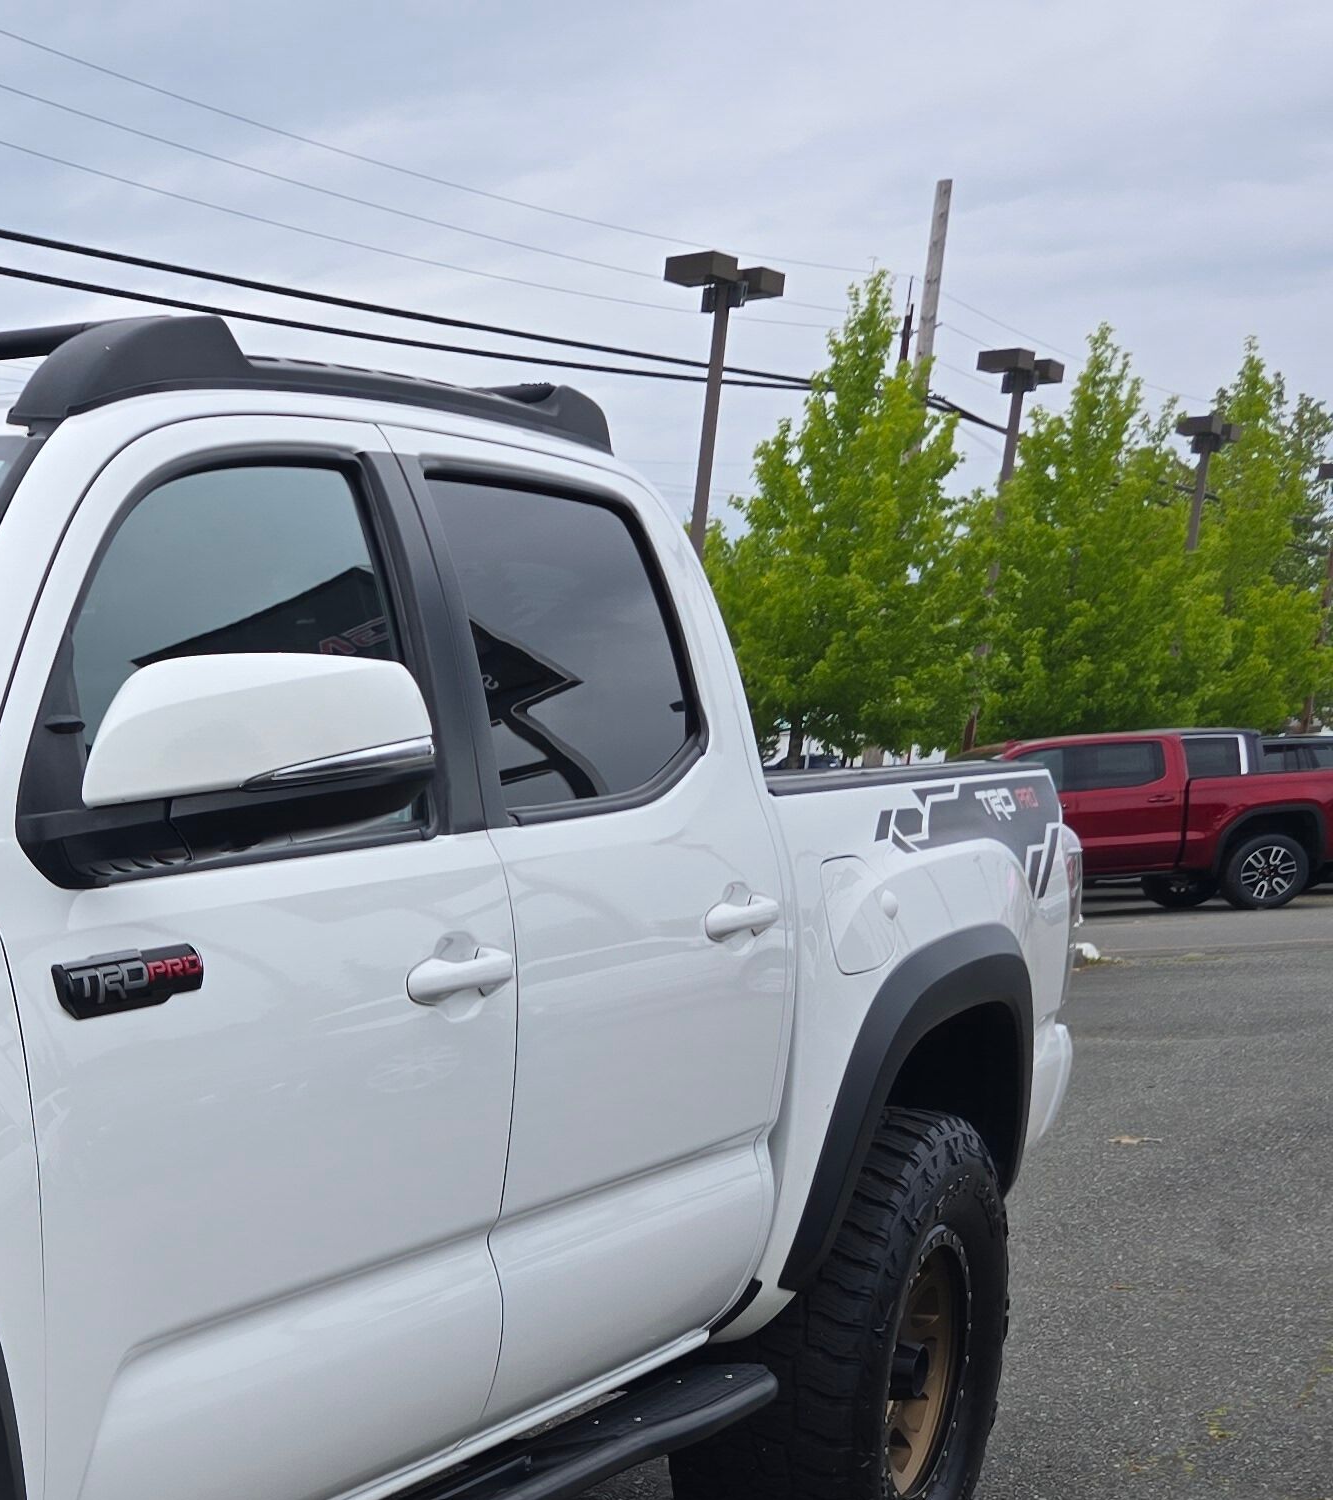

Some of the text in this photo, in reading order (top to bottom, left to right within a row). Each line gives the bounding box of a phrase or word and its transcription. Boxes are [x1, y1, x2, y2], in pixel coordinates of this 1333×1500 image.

[974, 788, 1016, 821] TRD
[68, 955, 202, 1004] TRD PRO
